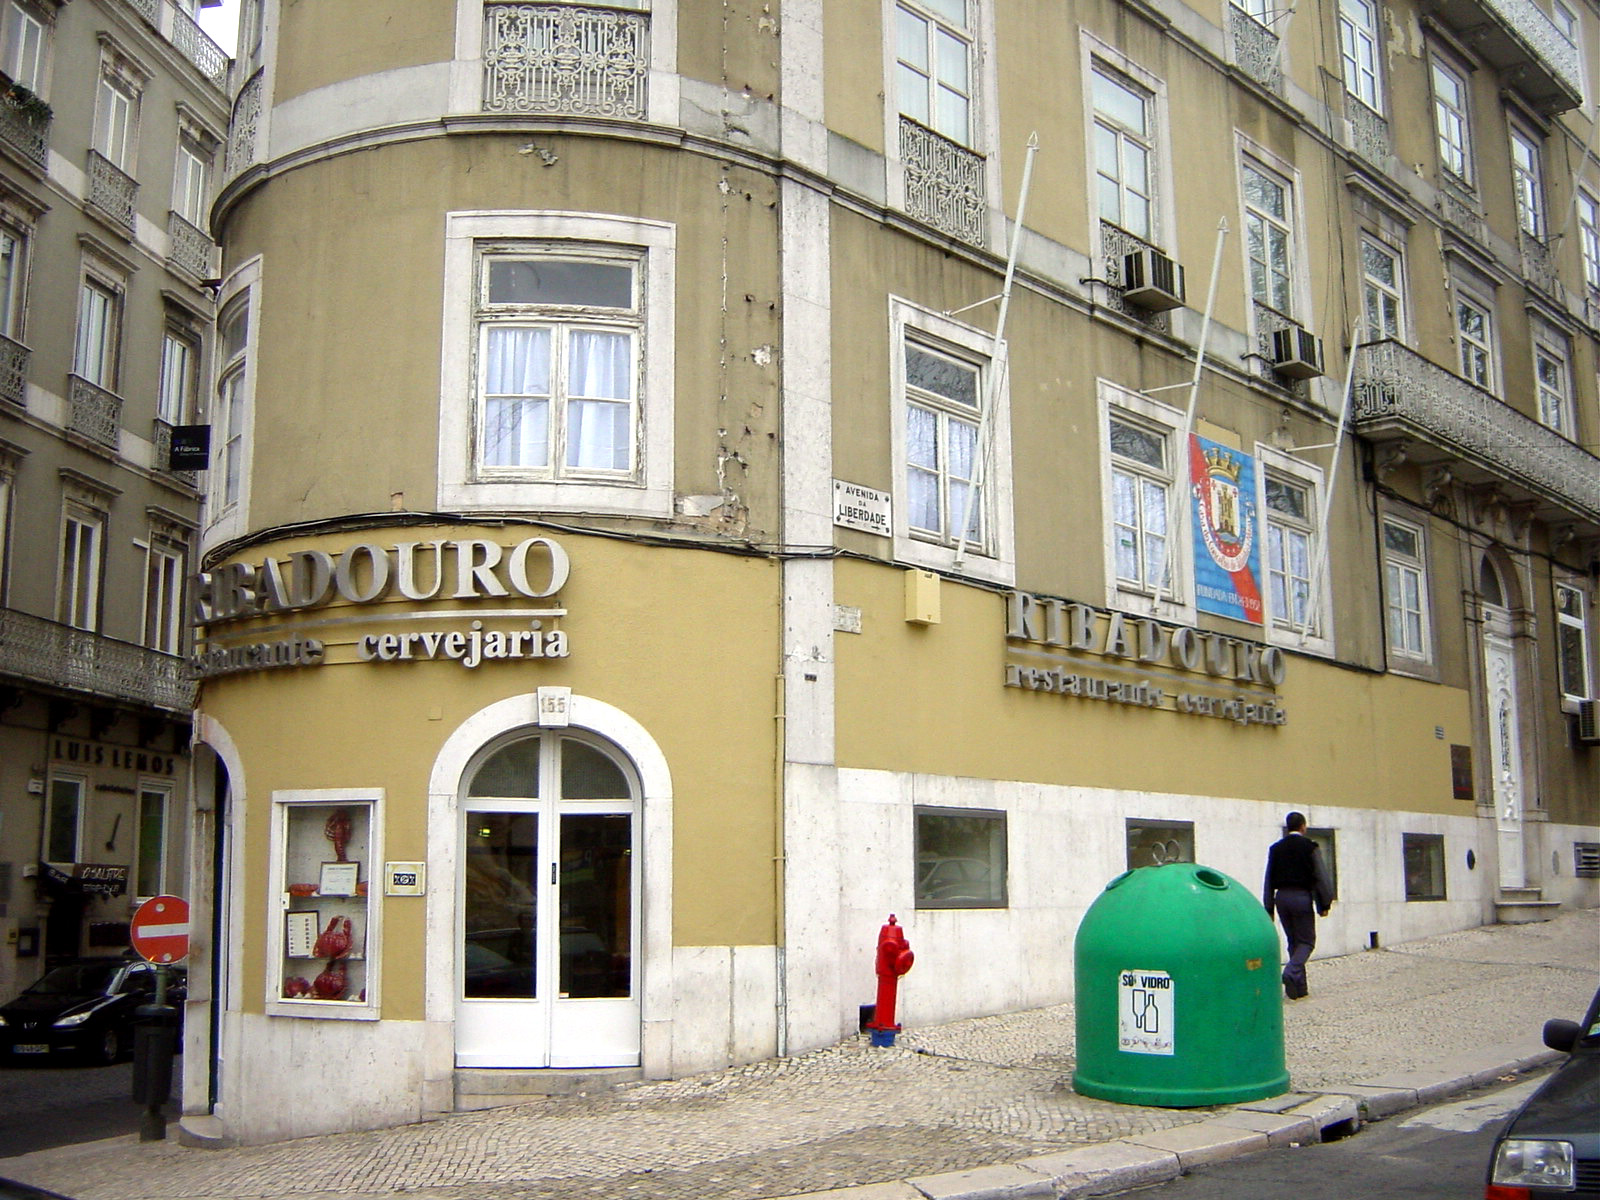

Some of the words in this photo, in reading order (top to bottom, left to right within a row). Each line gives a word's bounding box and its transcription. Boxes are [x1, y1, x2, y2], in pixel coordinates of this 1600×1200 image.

[845, 486, 879, 502] AVENIDA
[839, 503, 887, 526] LIBERDADE
[188, 537, 570, 627] RIBADOURO
[358, 620, 570, 668] cervejaria
[1002, 590, 1286, 686] RIBADOURO
[541, 697, 566, 714] 155
[1003, 664, 1165, 707] restaurante
[1177, 695, 1287, 726] cervejaria
[55, 739, 104, 765] LUIS
[112, 749, 174, 776] LEMOS
[1141, 976, 1170, 989] VIDRO
